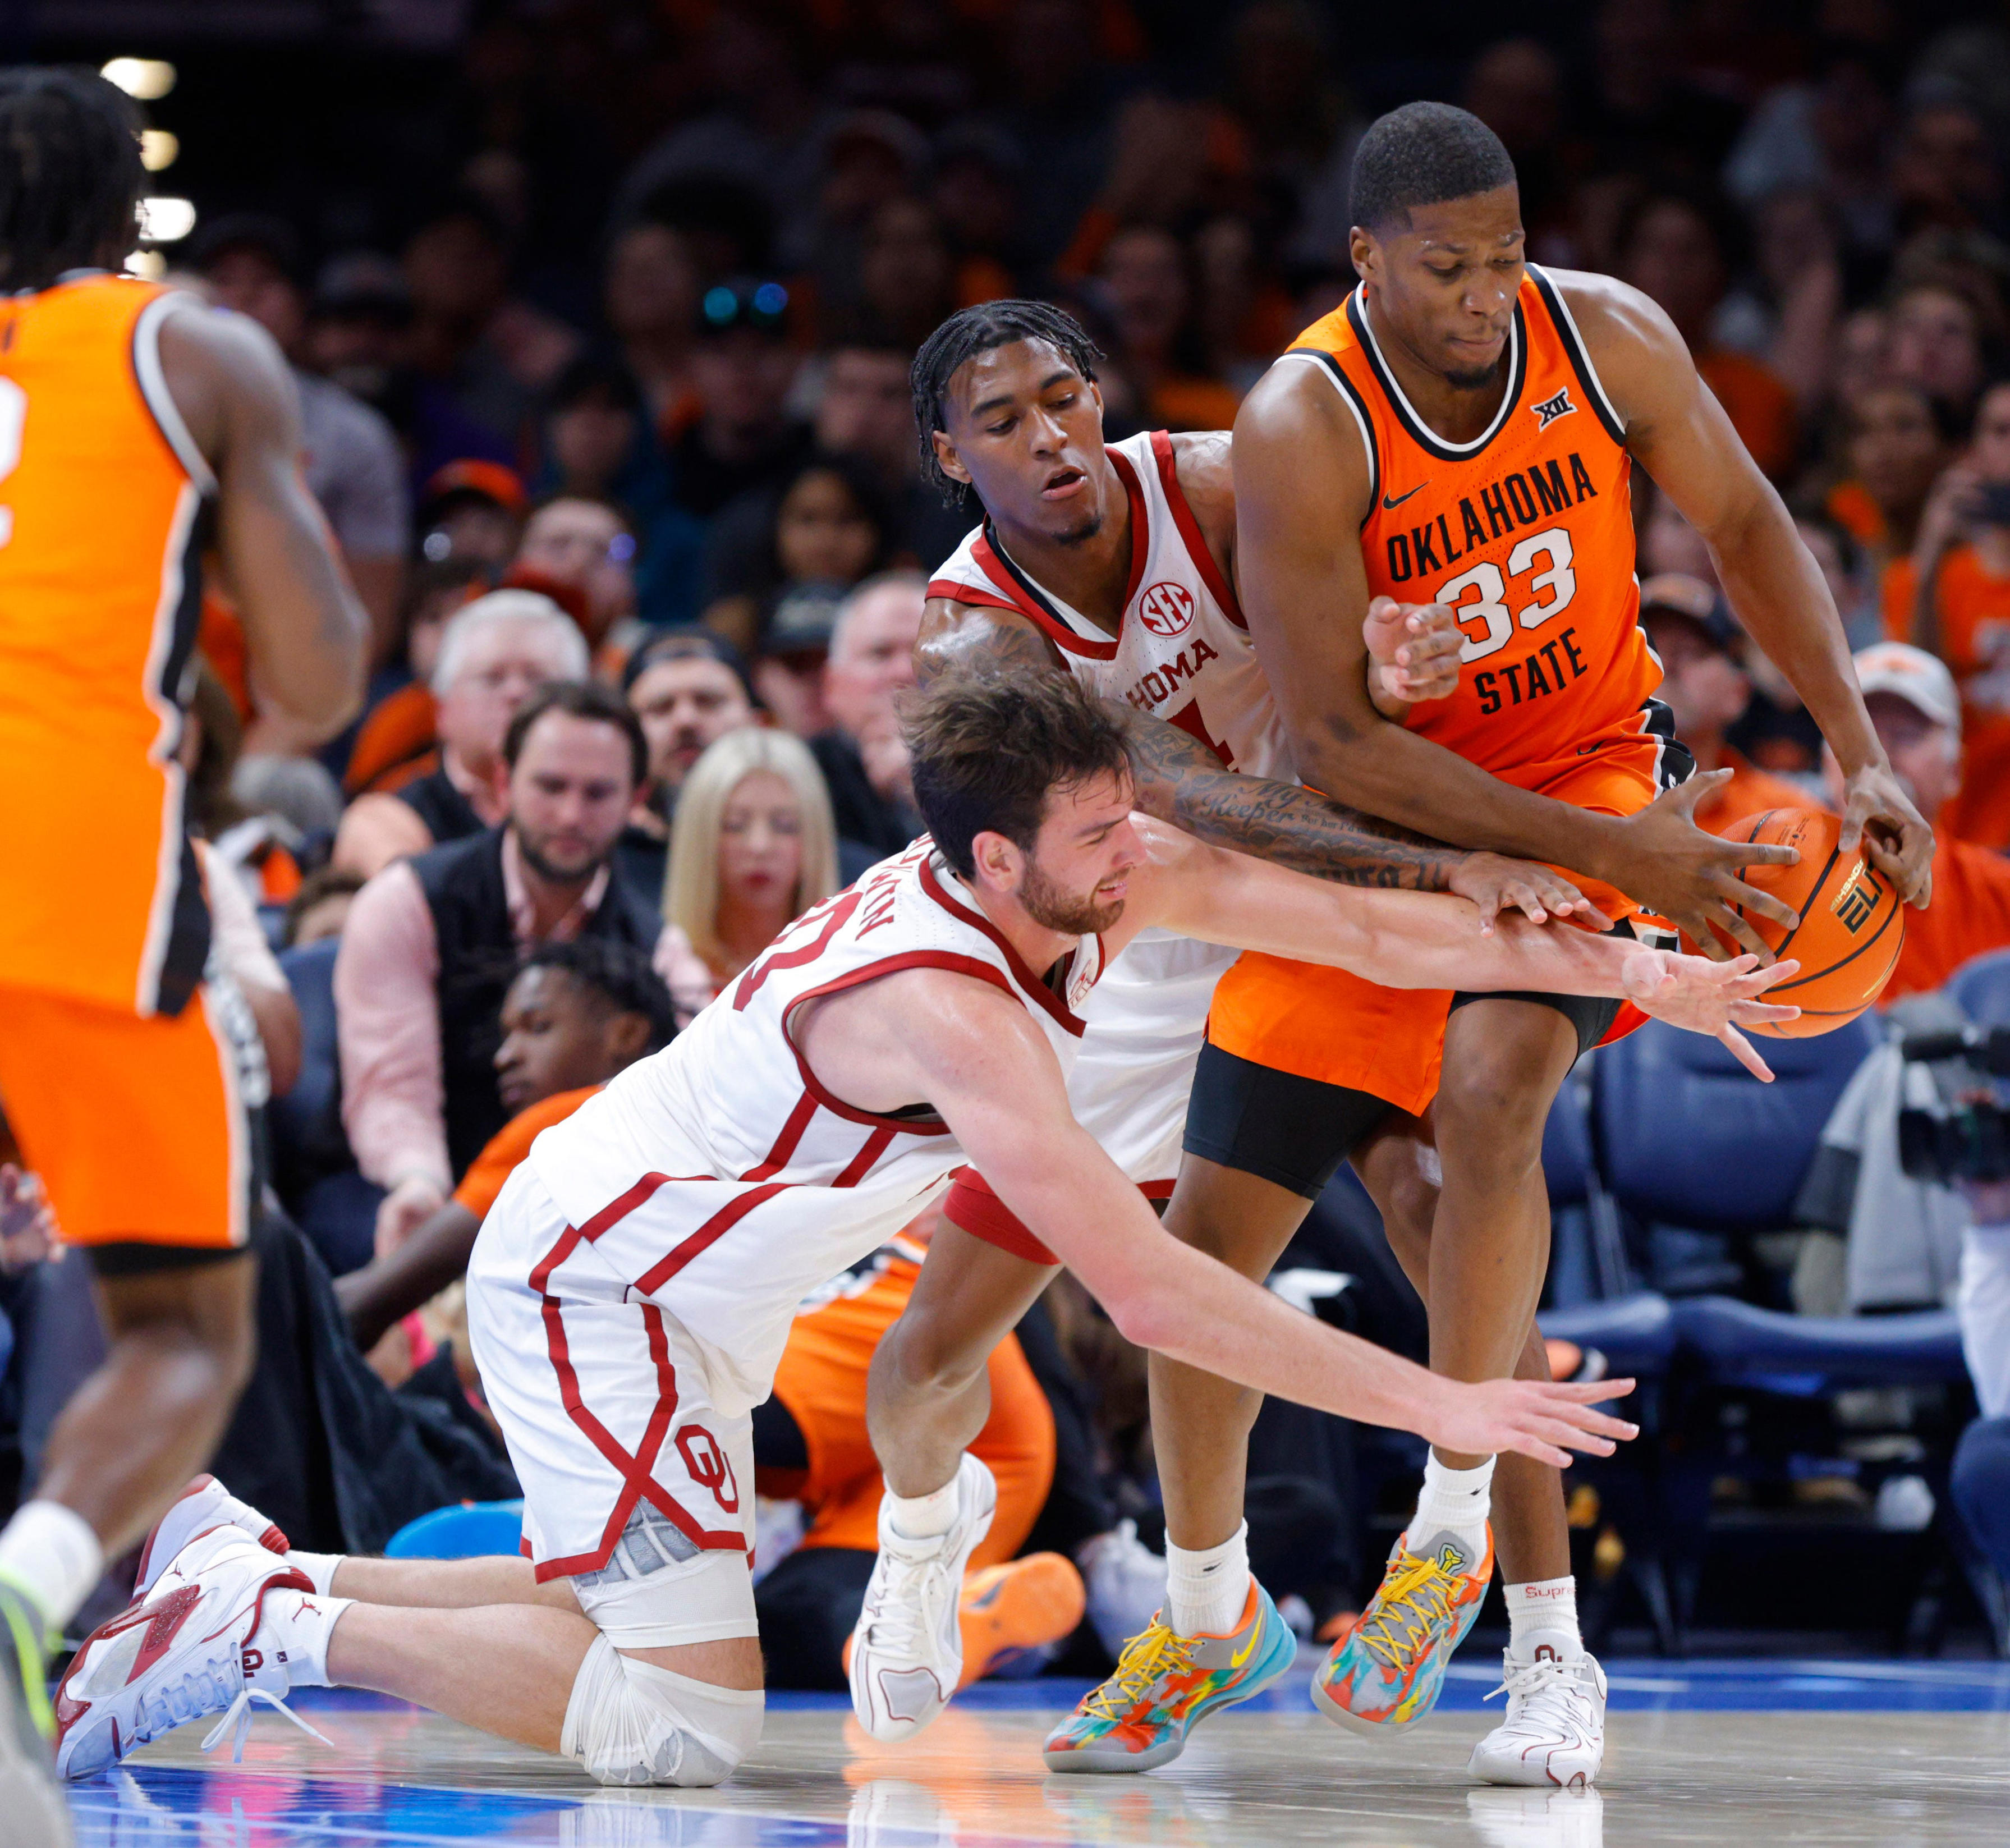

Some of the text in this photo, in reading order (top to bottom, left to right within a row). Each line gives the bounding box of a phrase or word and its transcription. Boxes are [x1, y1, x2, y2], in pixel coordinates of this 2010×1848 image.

[1534, 390, 1575, 425] XII
[1387, 452, 1598, 583] OKLAHOMA
[1141, 584, 1194, 635] SEC
[1435, 526, 1577, 664] 33
[1126, 638, 1219, 711] HOMA
[1474, 627, 1588, 715] STATE
[674, 1424, 739, 1514] OU
